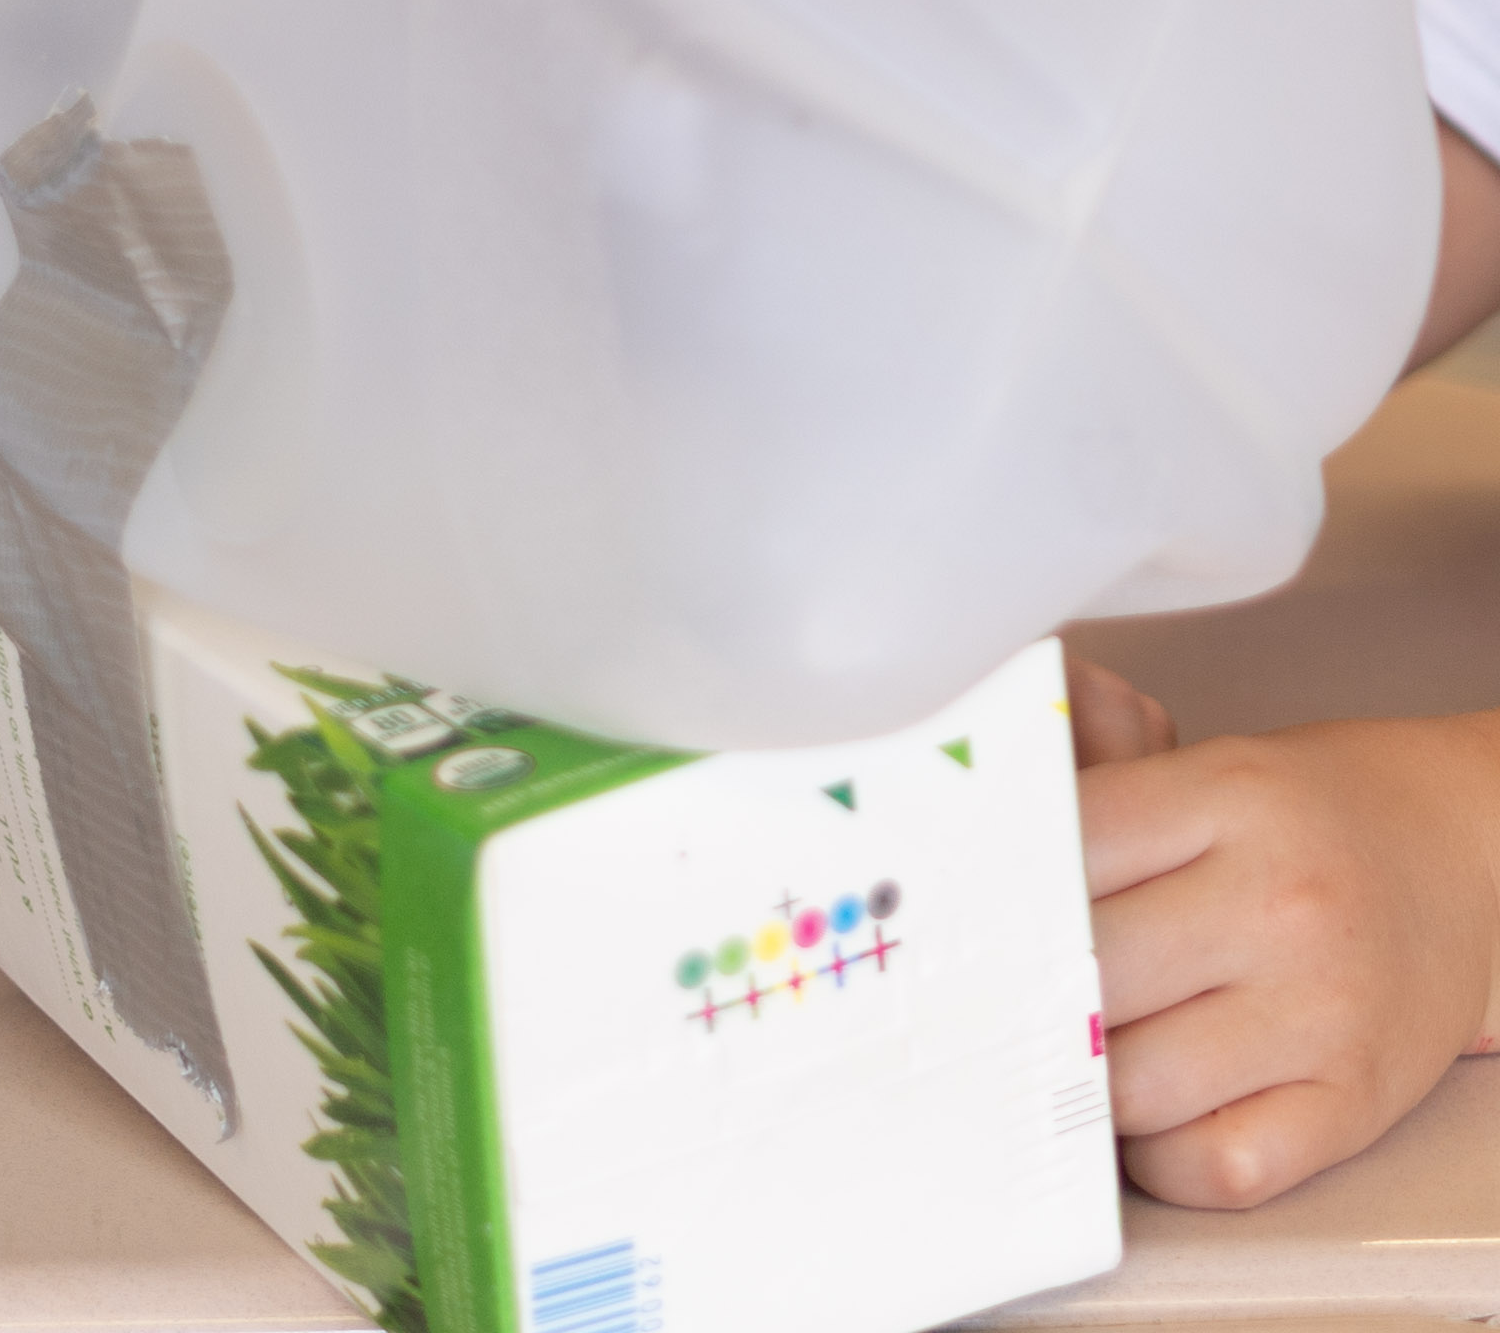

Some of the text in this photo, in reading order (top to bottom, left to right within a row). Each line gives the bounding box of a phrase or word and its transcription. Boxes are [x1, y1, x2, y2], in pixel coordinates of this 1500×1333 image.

[7, 716, 22, 745] so
[14, 748, 36, 800] milk
[28, 802, 46, 846] our
[40, 848, 68, 923] makes
[62, 928, 86, 988] What
